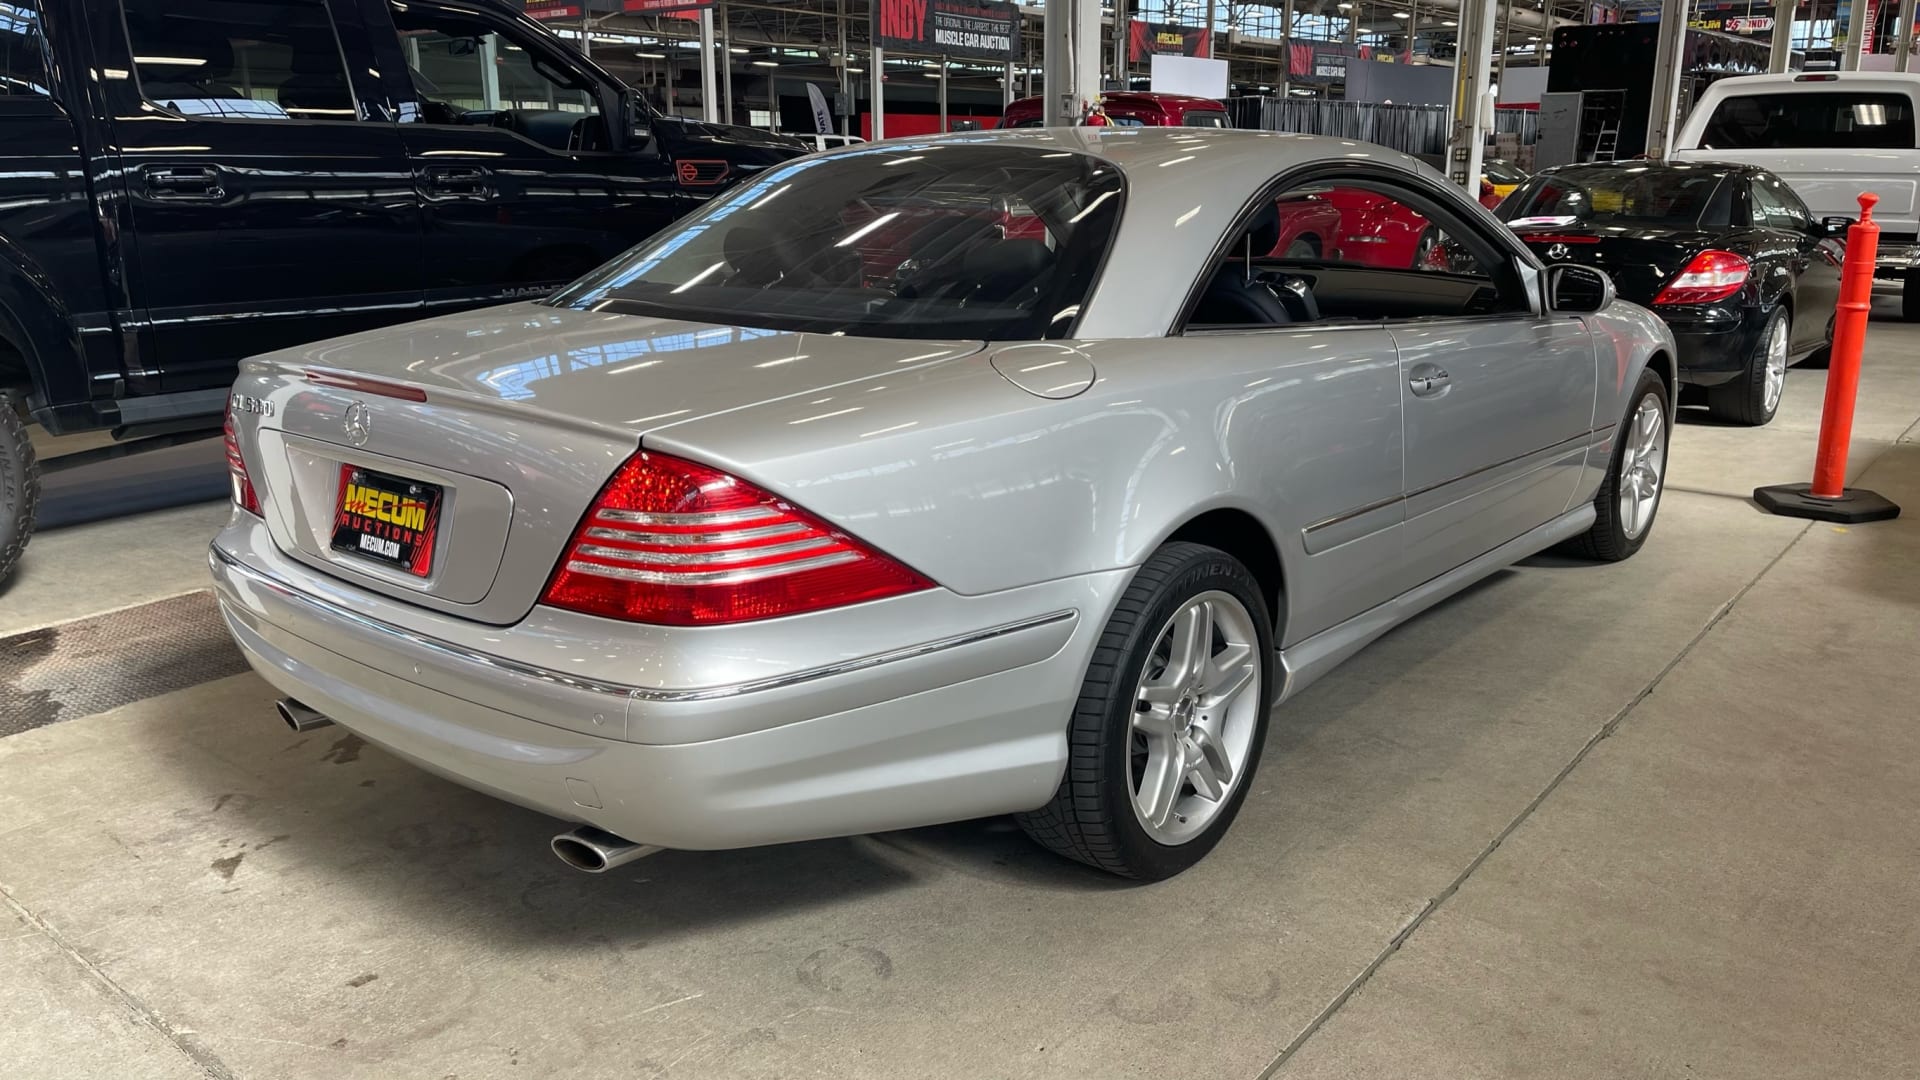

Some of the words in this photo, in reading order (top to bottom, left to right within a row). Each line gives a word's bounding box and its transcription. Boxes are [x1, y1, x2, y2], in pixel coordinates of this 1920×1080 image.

[880, 0, 927, 42] INDY
[935, 16, 944, 27] THE
[963, 20, 972, 30] THE
[991, 22, 1000, 33] THE
[999, 24, 1011, 34] BEST
[1687, 20, 1721, 30] ECUM
[1748, 18, 1769, 29] INDY
[935, 29, 964, 46] MUSCLE
[963, 32, 980, 48] CAR
[980, 35, 1011, 51] AUCTION
[502, 284, 564, 297] HARLE
[344, 483, 427, 532] MECUM
[341, 513, 423, 546] AUCTIONS
[359, 533, 400, 559] MECUM.COM
